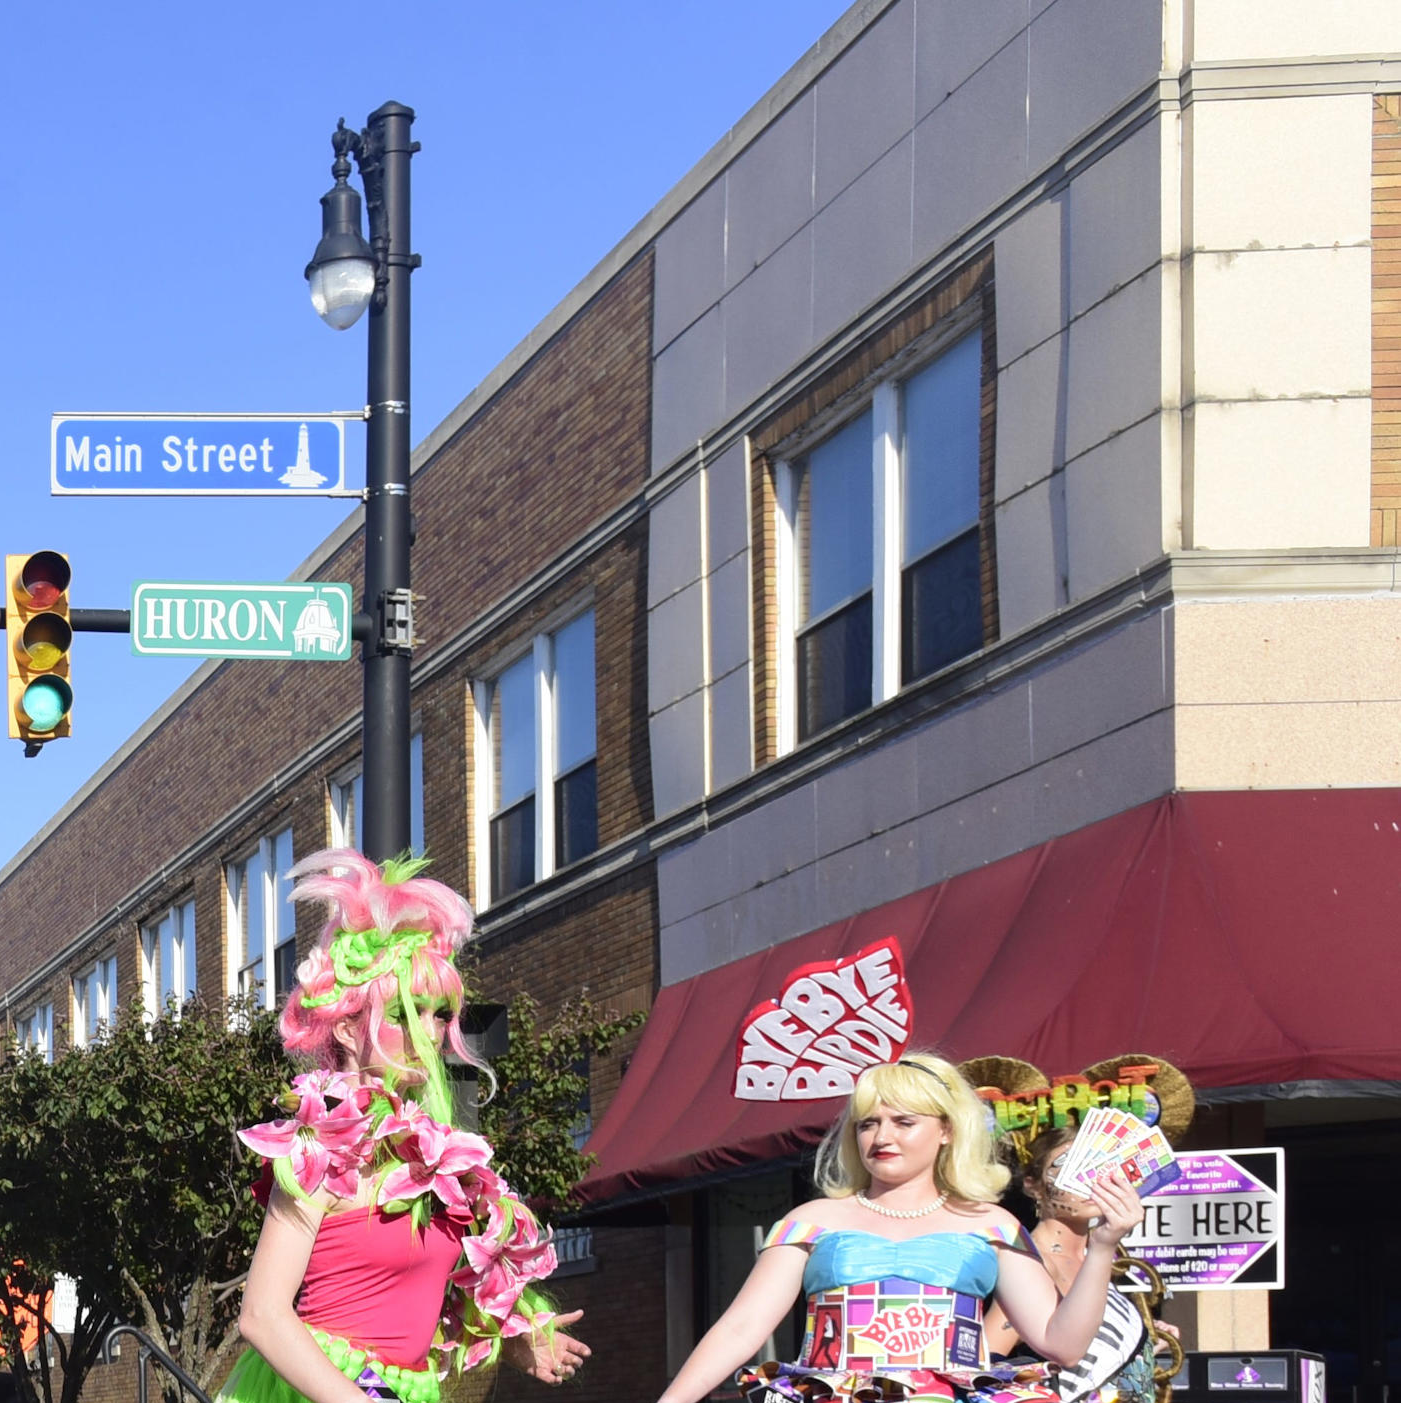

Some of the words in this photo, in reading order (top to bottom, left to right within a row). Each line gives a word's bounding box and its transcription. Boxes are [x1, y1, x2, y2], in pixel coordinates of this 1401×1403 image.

[65, 437, 142, 472] Main
[162, 436, 274, 473] Street
[143, 598, 287, 642] HURON
[734, 1008, 817, 1101] BYE
[780, 947, 899, 1034] BYE
[780, 987, 909, 1099] BIRDIE
[1187, 1171, 1222, 1179] favorite
[1192, 1201, 1273, 1236] HERE
[858, 1312, 905, 1343] BYE
[905, 1306, 945, 1329] BYE
